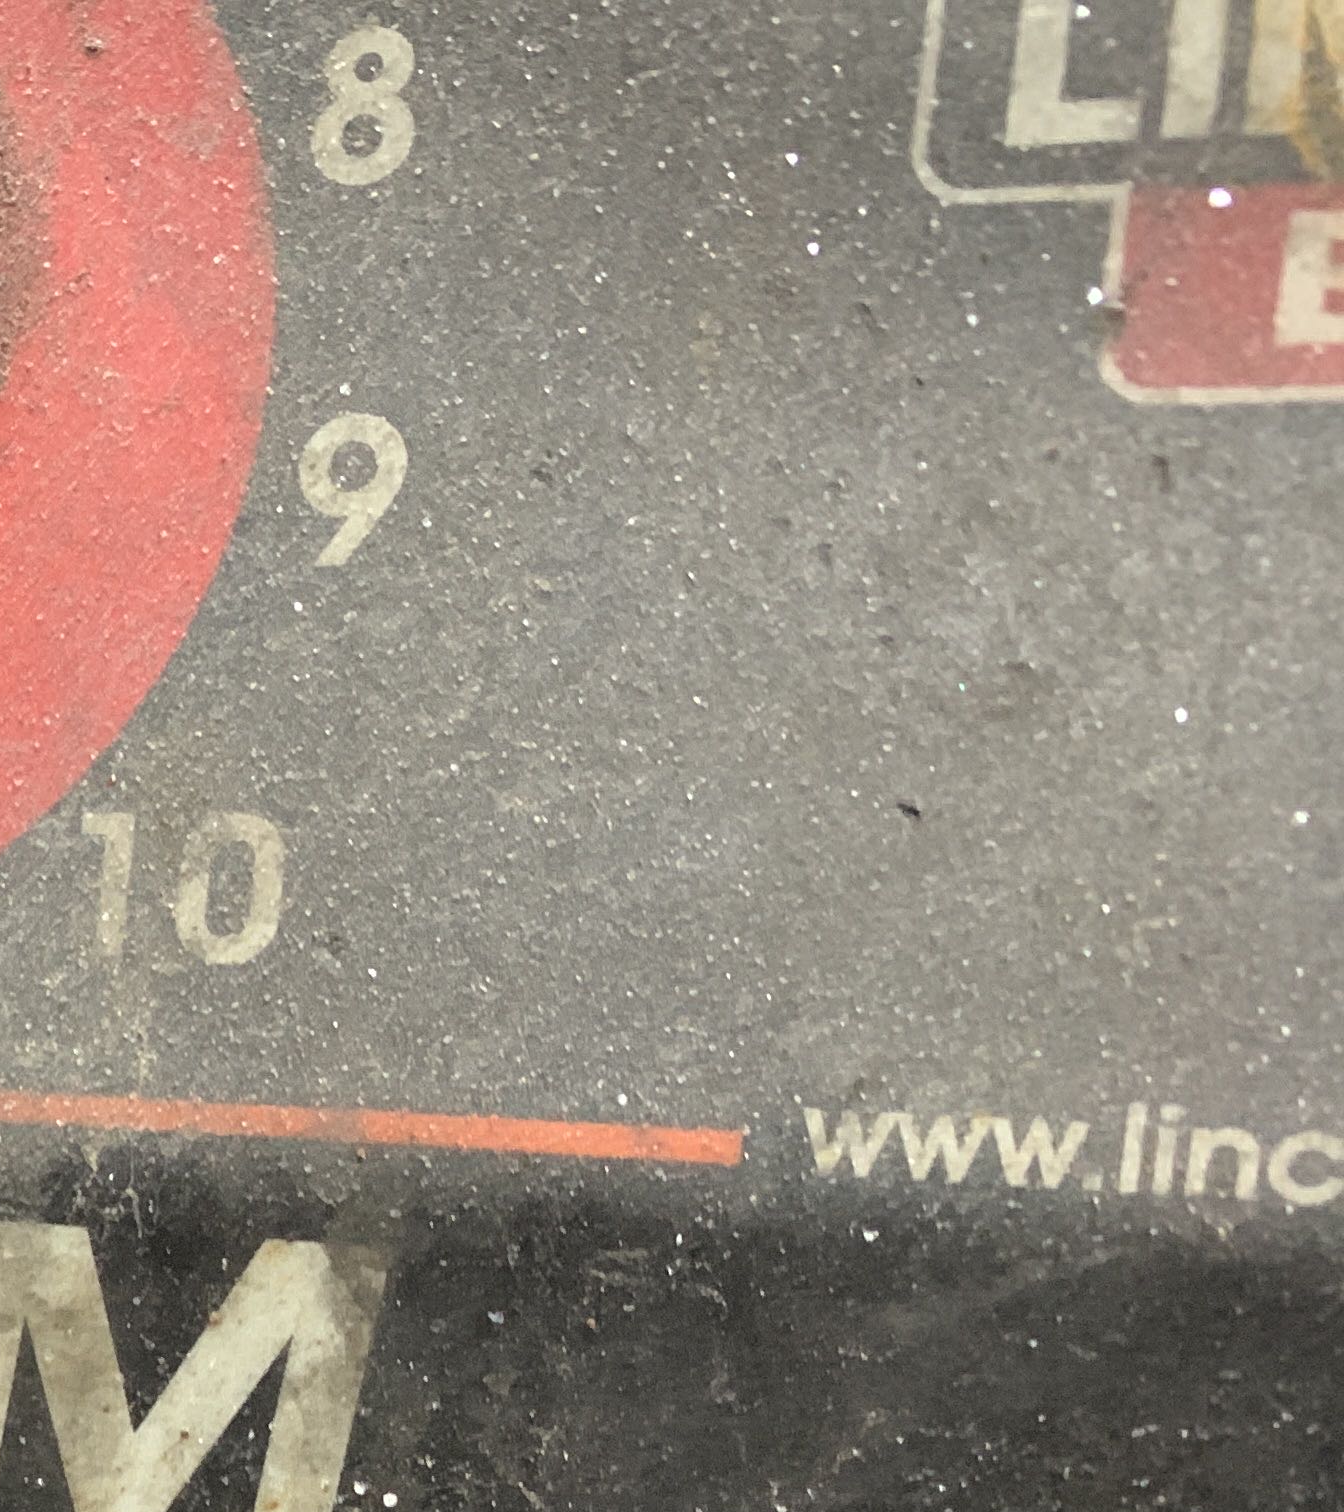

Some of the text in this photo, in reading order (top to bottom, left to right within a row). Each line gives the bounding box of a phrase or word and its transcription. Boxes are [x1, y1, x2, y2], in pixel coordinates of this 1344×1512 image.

[312, 24, 415, 186] 8
[298, 412, 408, 567] 9
[82, 810, 284, 966] 10
[804, 1102, 1344, 1205] www.linc
